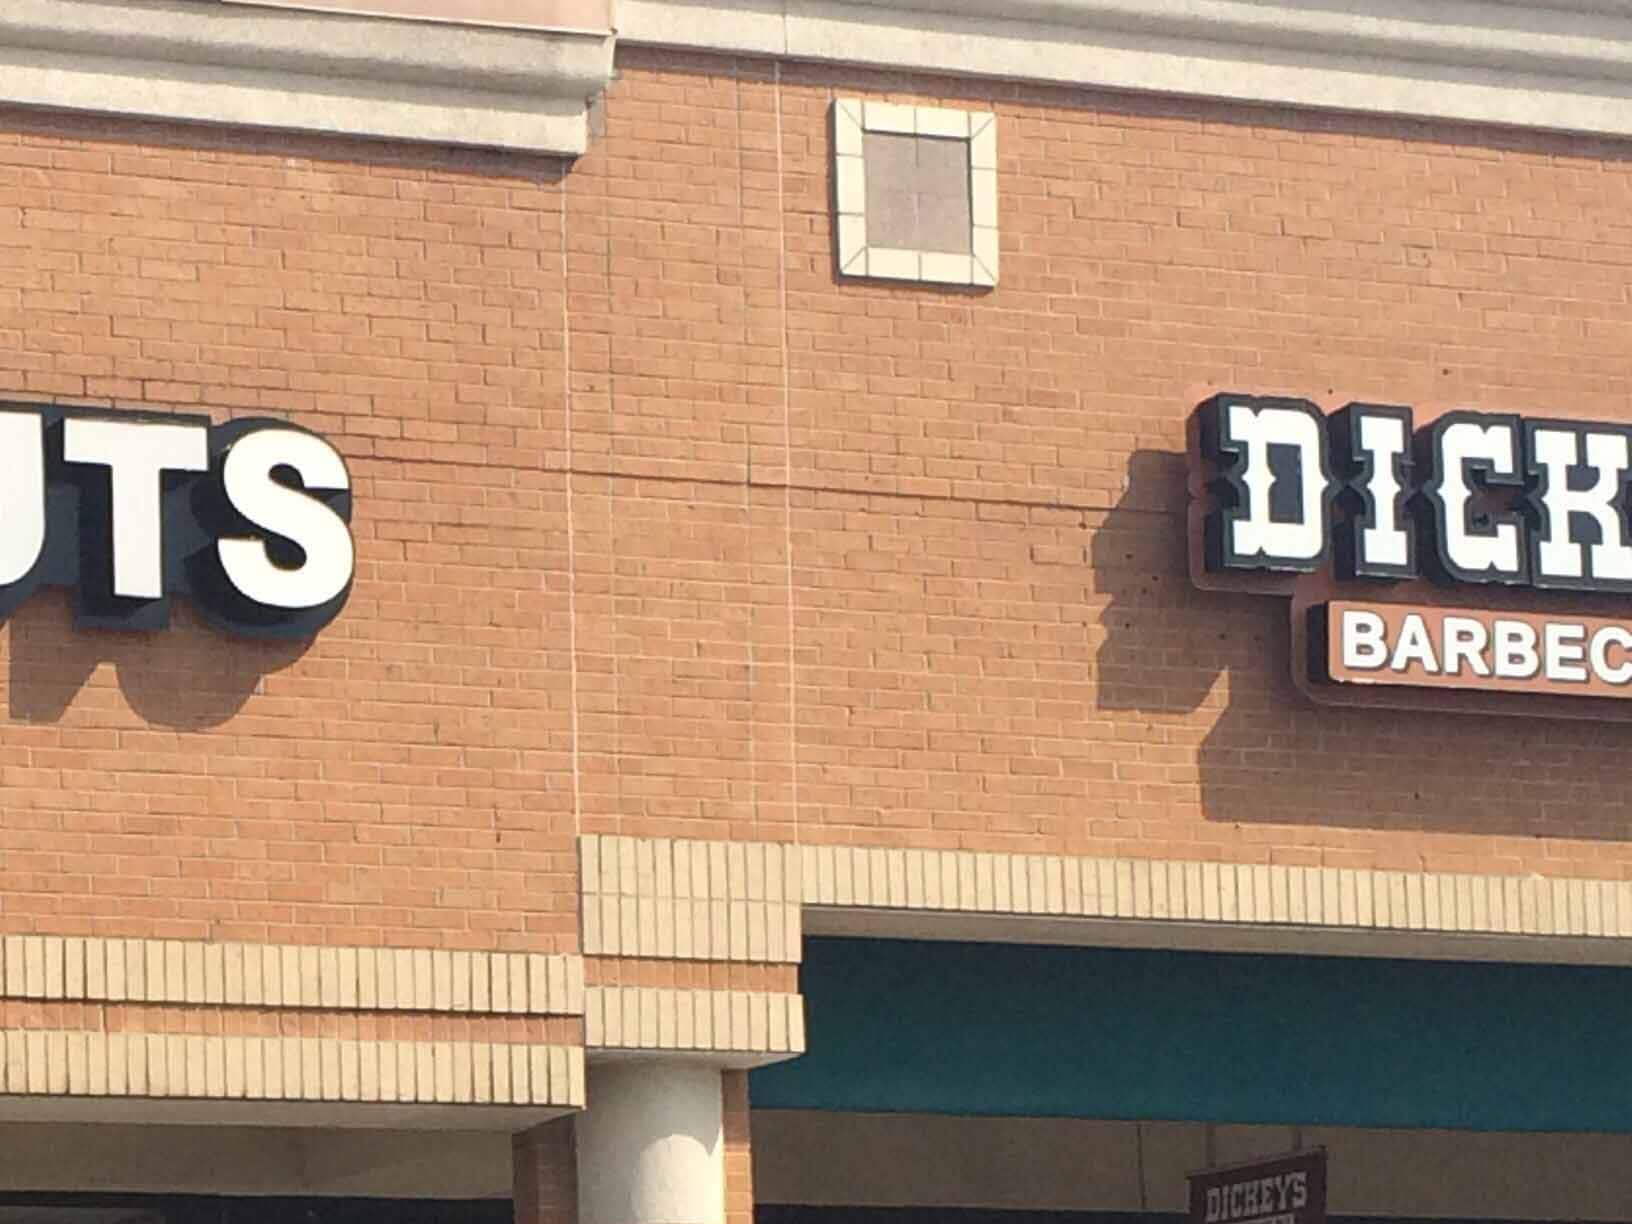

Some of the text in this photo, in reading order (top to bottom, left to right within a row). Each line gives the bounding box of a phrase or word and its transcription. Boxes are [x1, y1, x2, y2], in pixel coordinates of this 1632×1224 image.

[1228, 404, 1632, 580] DICK
[1341, 609, 1632, 685] BARBEC
[1204, 1171, 1308, 1224] DICKEY'S
